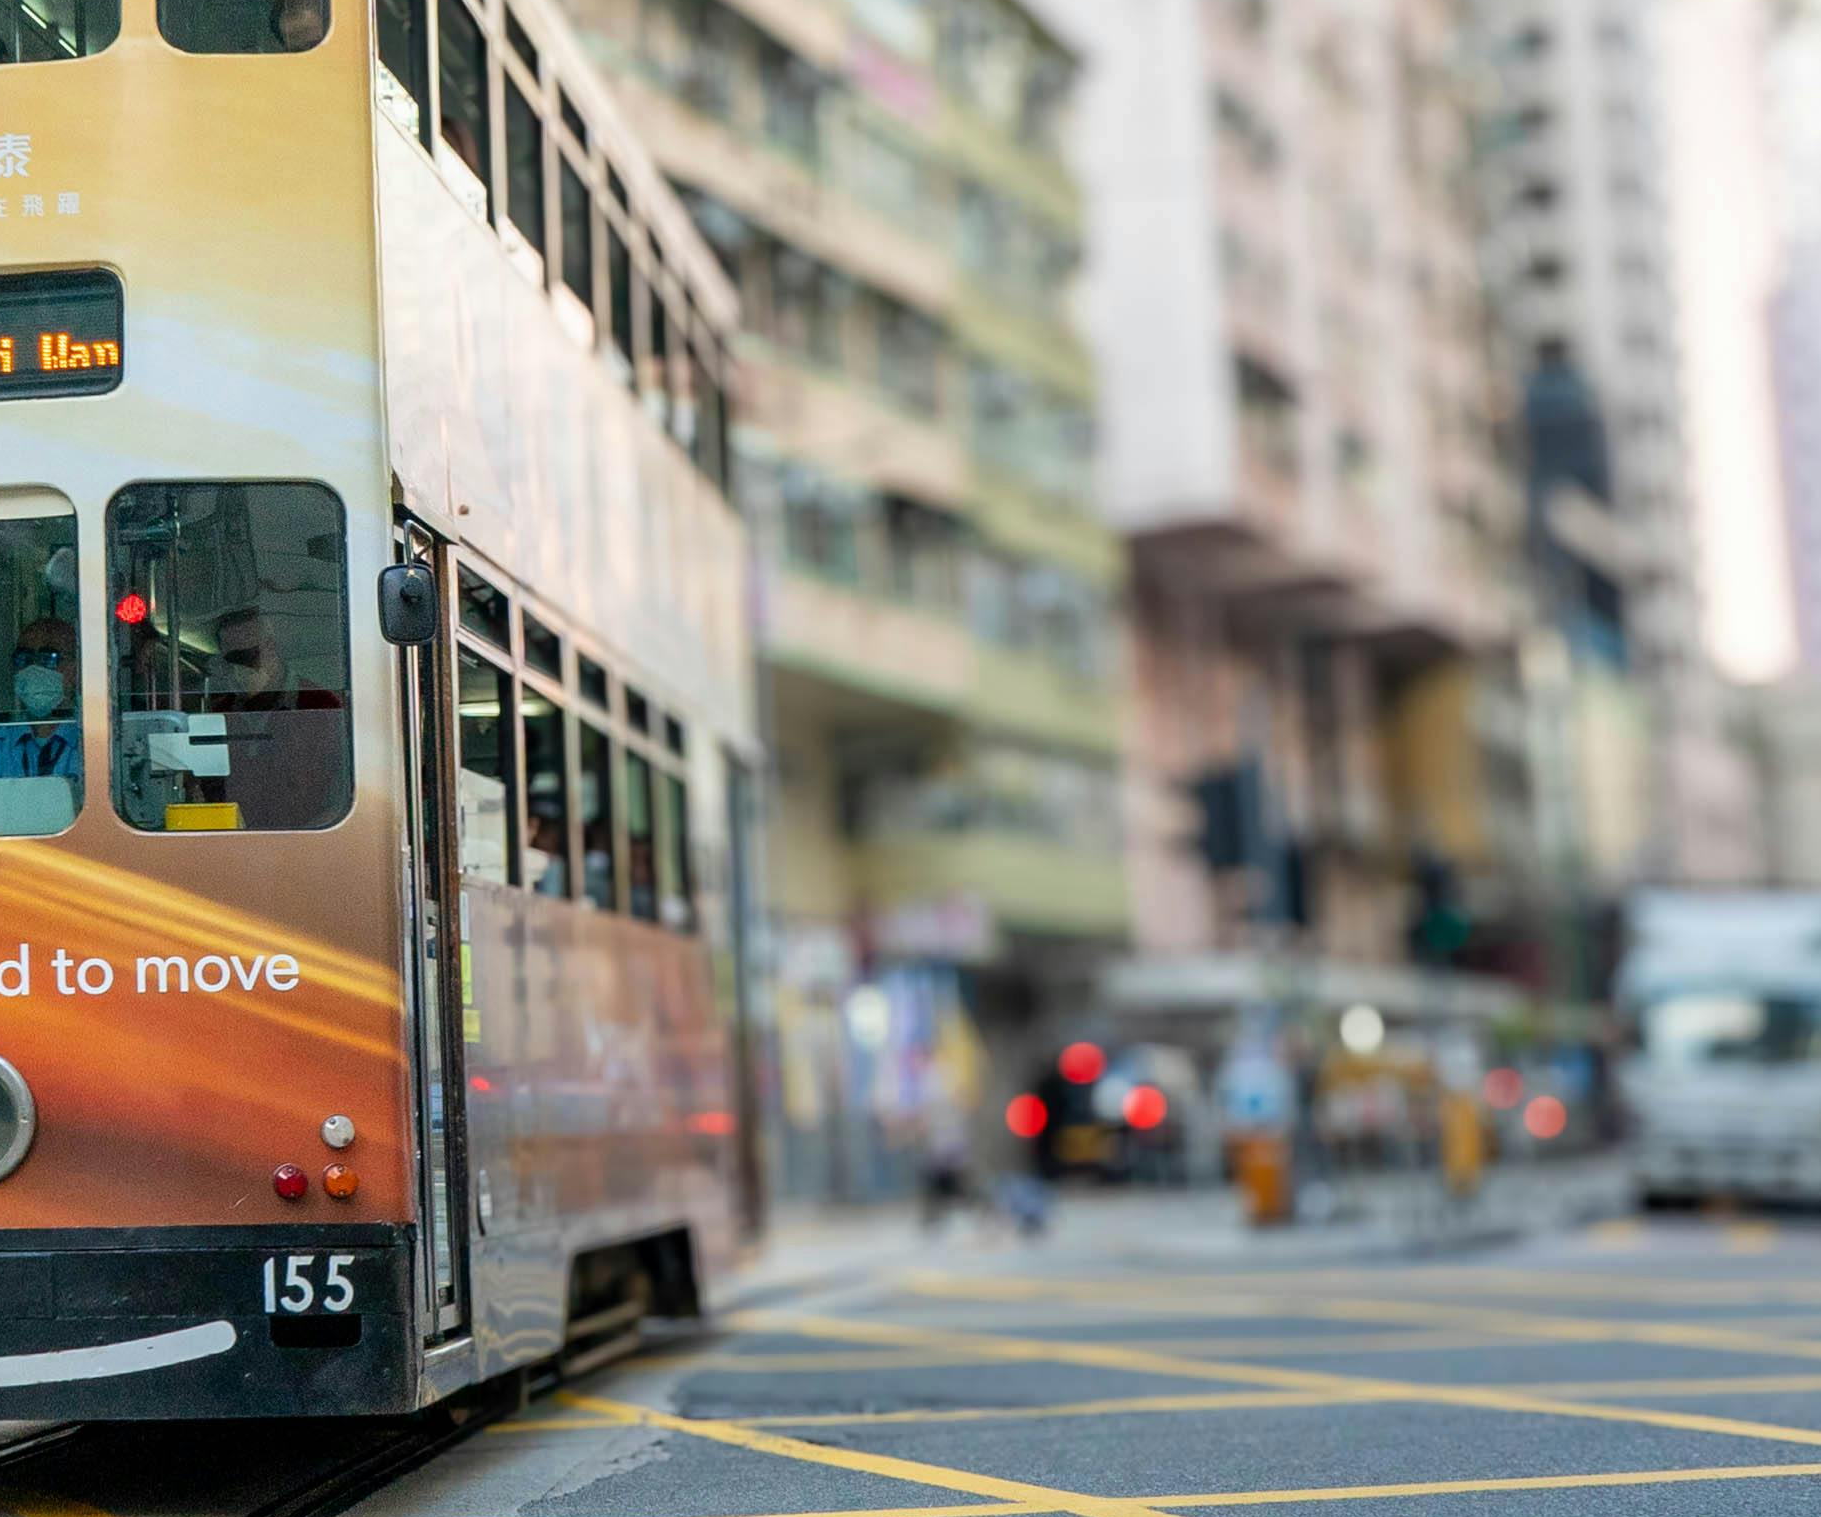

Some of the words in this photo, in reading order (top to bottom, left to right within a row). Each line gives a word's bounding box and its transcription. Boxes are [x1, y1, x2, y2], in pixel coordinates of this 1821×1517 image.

[51, 948, 113, 996] to
[136, 952, 300, 994] move
[264, 1255, 355, 1313] 155
